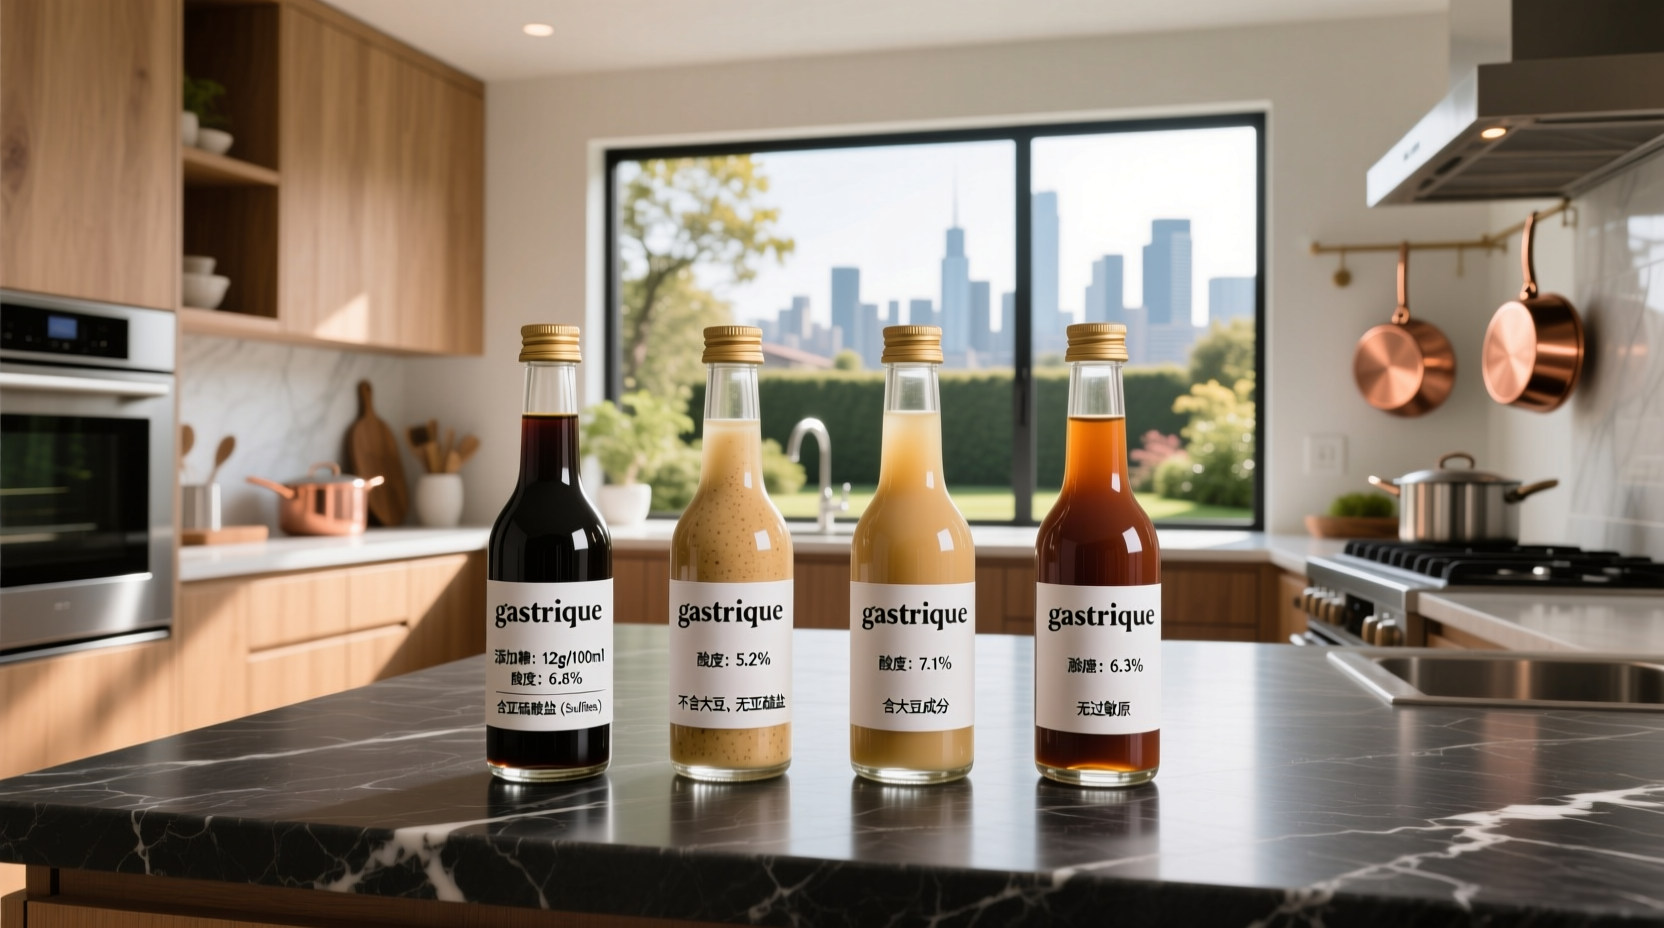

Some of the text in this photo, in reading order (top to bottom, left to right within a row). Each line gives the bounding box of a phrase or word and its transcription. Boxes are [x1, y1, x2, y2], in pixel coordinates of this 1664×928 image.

[495, 598, 602, 629] gastrique
[678, 598, 783, 629] gastrique
[862, 601, 968, 631] gastrique
[1048, 602, 1155, 632] gastrique
[882, 697, 950, 715] 含大豆成分
